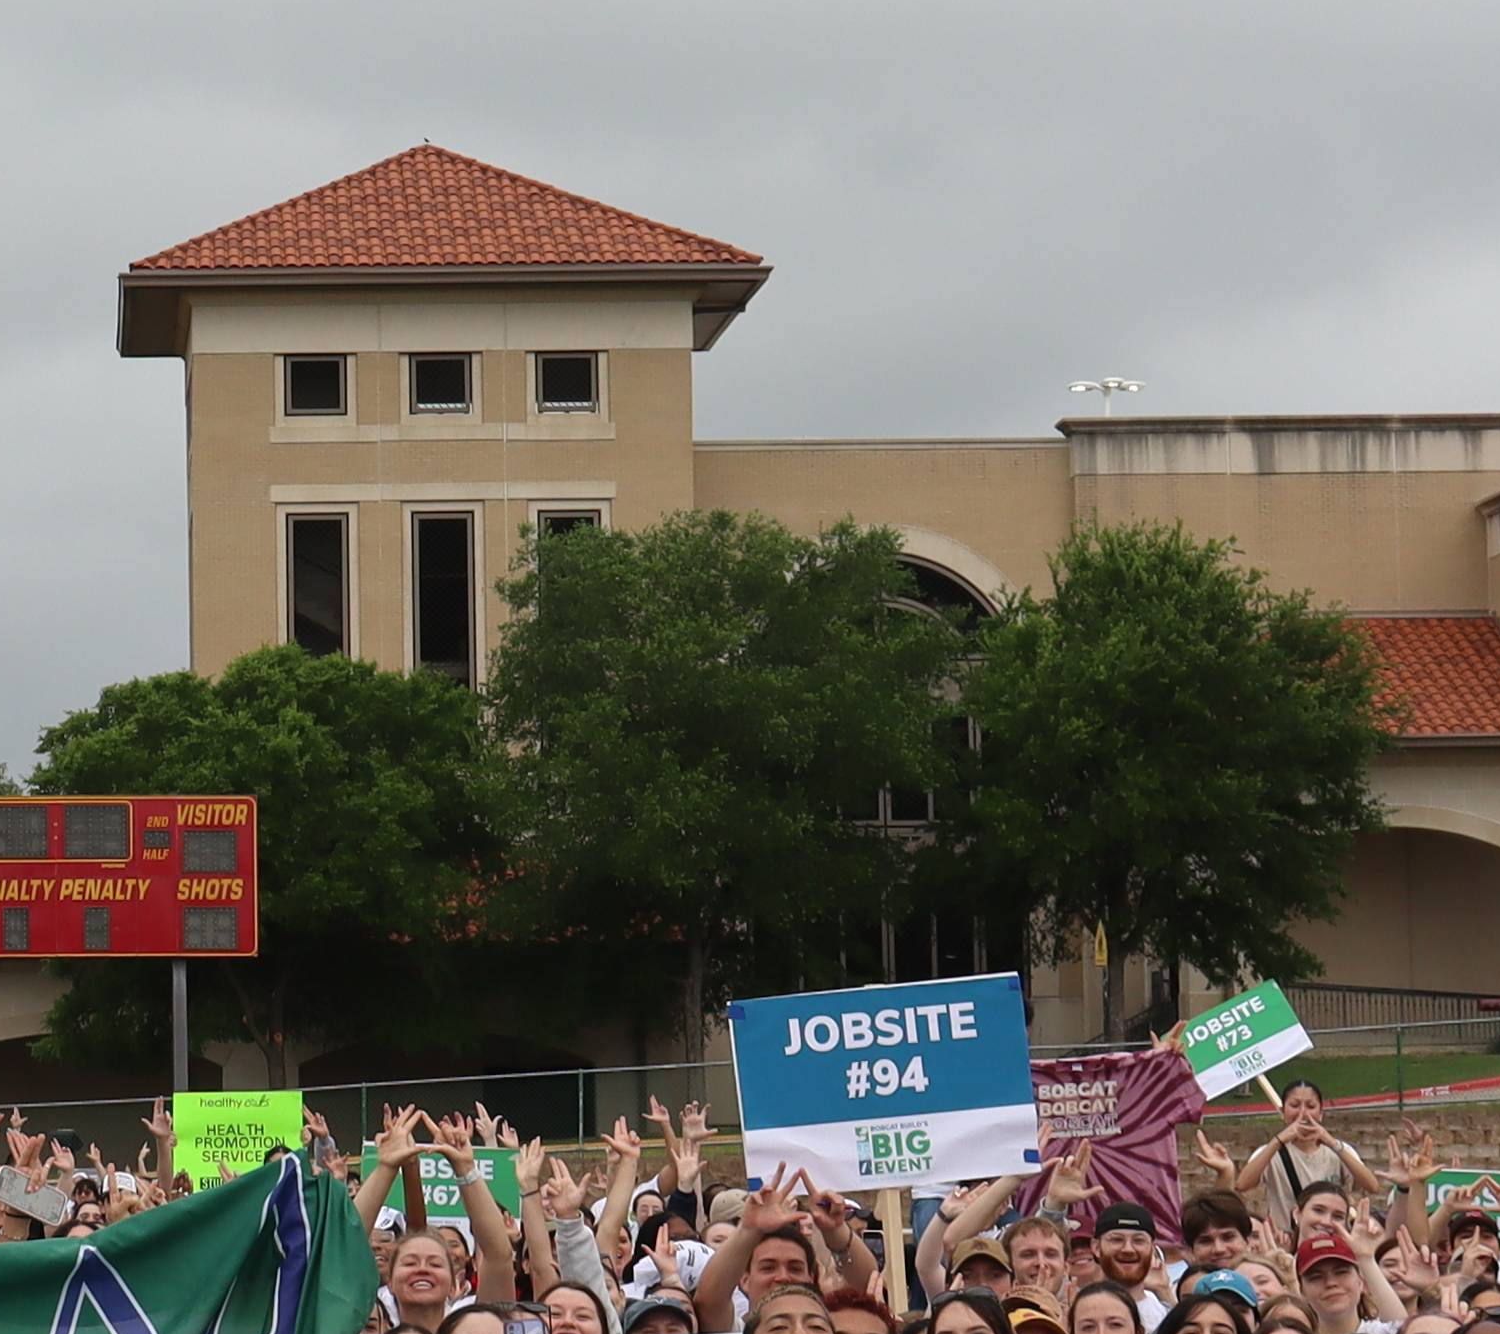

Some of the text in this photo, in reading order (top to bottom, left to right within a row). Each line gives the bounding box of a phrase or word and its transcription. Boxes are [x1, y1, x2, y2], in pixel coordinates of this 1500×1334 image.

[146, 816, 169, 828] 2ND
[177, 804, 248, 826] VISITOR
[143, 848, 170, 860] HALF
[59, 878, 151, 901] PENALTY
[177, 878, 244, 900] SHOTS
[784, 1002, 978, 1056] JOBSITE
[1184, 995, 1265, 1047] JOBSITE
[1215, 1024, 1253, 1052] #73
[1236, 1051, 1264, 1069] BIG
[846, 1055, 930, 1098] #94
[1038, 1080, 1118, 1100] BOBCAT
[200, 1097, 242, 1108] healthy
[1039, 1098, 1118, 1117] BOBCAT
[206, 1124, 265, 1136] HEALTH
[870, 1123, 899, 1132] BOBCAT
[195, 1136, 285, 1149] PROMOTION
[871, 1130, 932, 1159] BIG
[875, 1156, 933, 1175] EVENT
